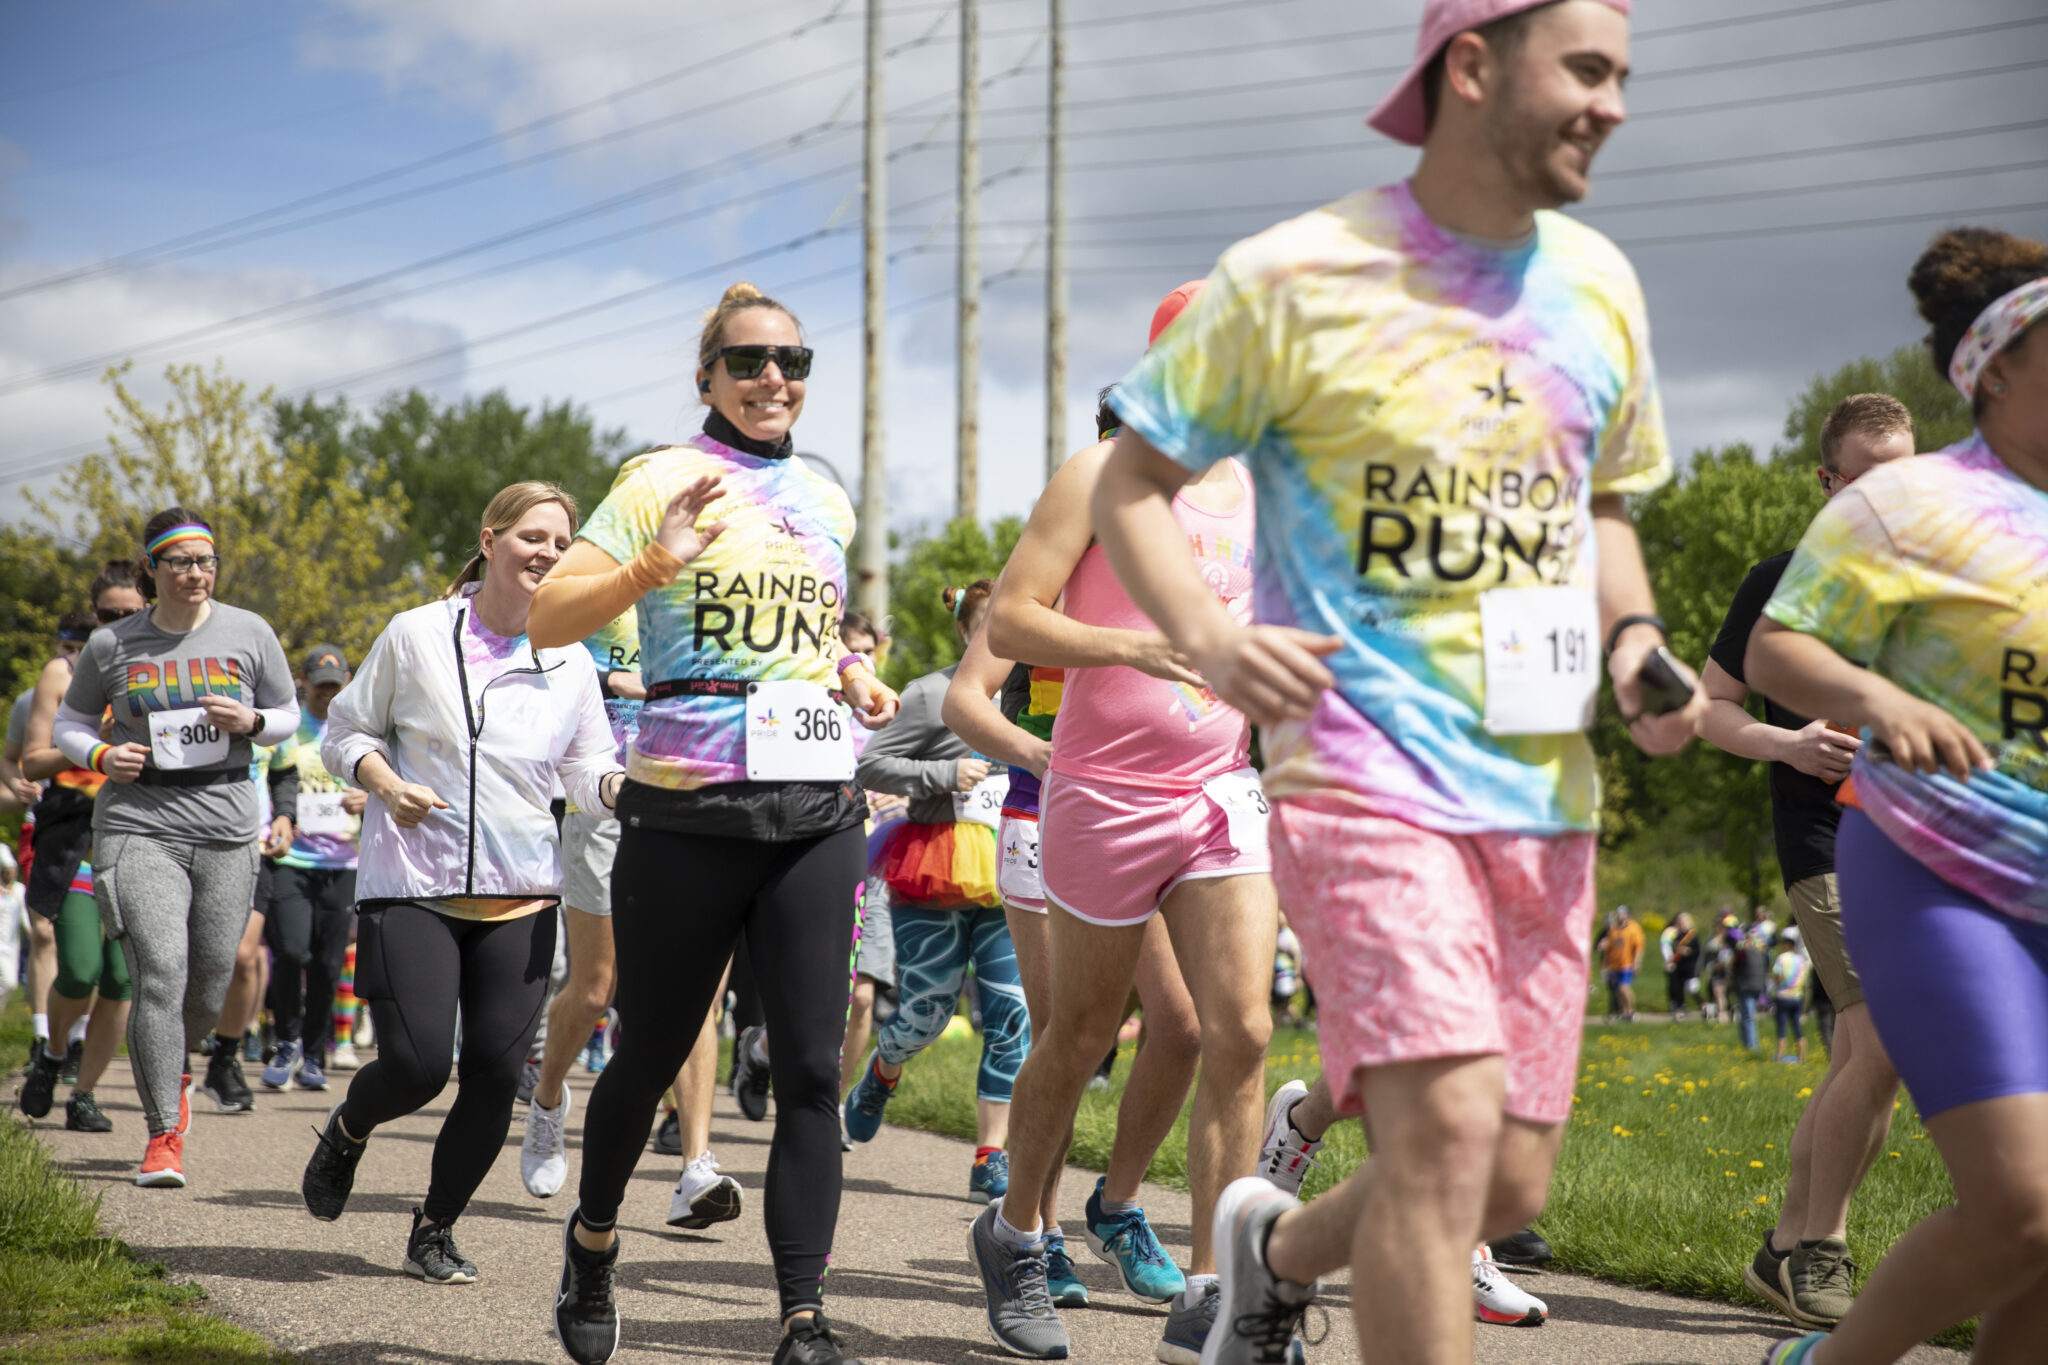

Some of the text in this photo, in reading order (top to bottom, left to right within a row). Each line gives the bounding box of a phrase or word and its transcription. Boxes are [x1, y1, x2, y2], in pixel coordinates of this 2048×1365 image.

[765, 540, 807, 553] PRIDE
[1356, 508, 1548, 582] RUN
[693, 603, 827, 658] RUN
[691, 657, 763, 667] PRESENTED BY
[1545, 627, 1587, 674] 191
[127, 656, 242, 718] RUN
[180, 724, 220, 746] 300
[750, 729, 778, 738] PRIDE
[794, 707, 841, 742] 366
